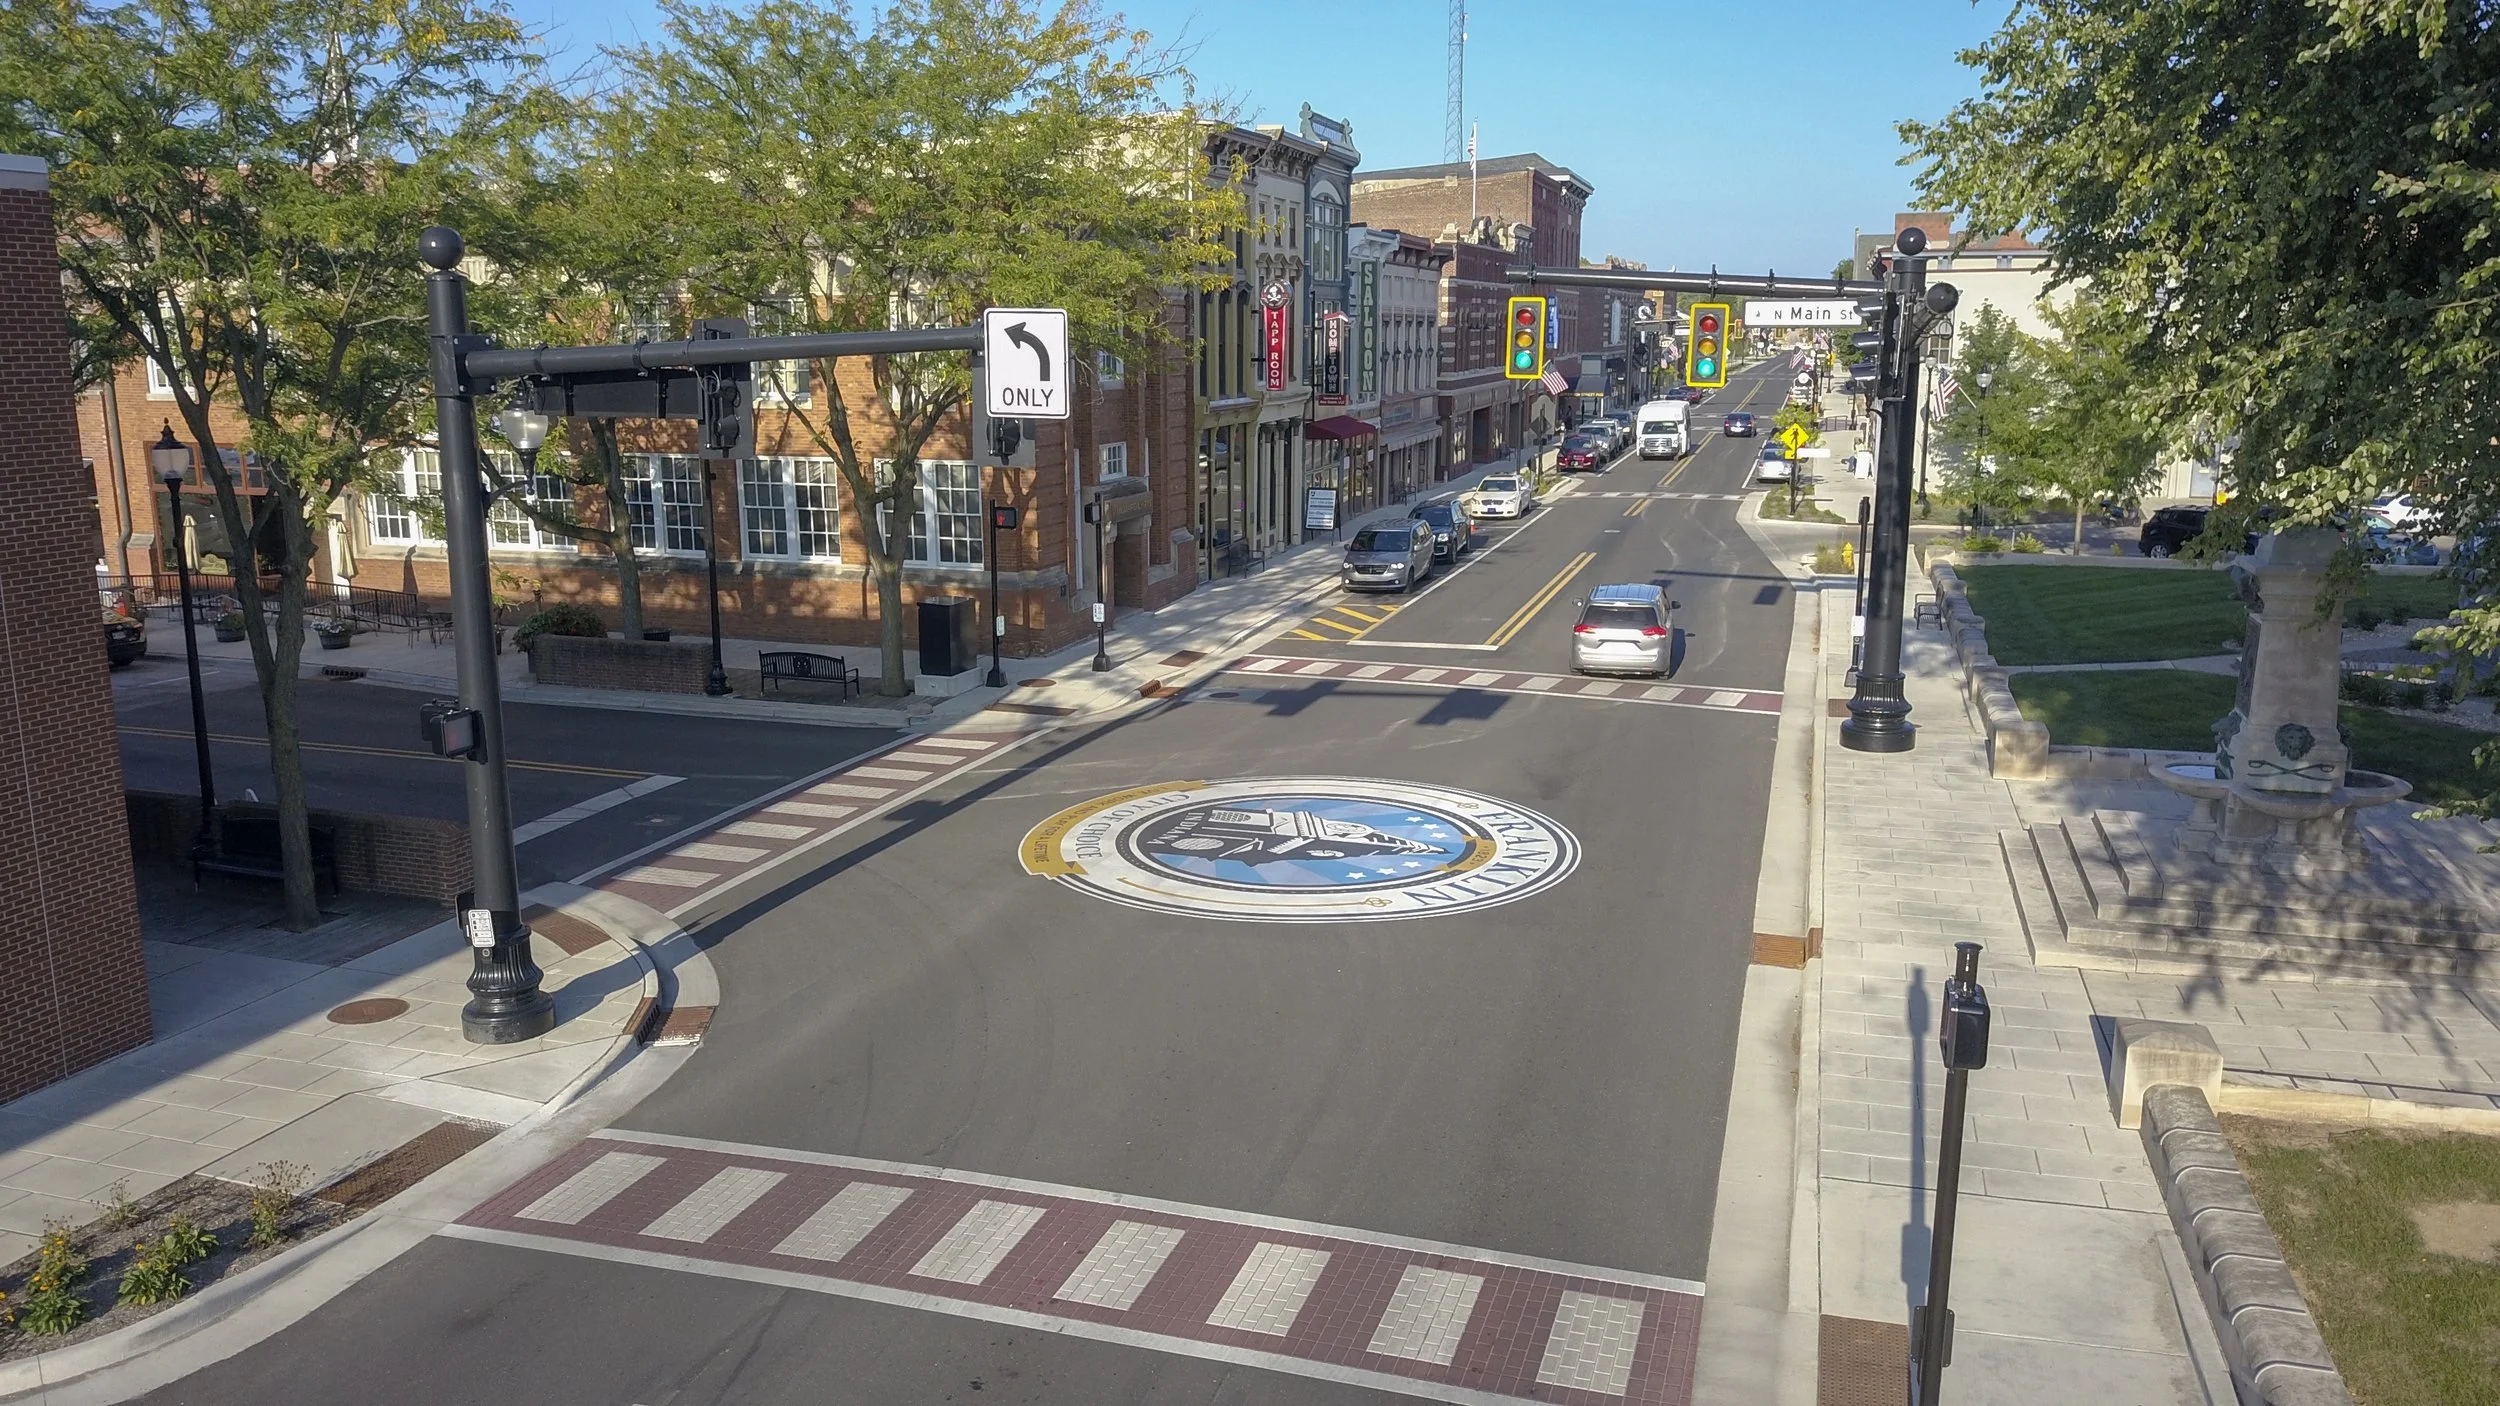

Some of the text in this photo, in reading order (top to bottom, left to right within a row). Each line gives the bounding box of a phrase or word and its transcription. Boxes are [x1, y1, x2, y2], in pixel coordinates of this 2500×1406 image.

[1363, 263, 1374, 391] SALOON
[1774, 306, 1853, 320] N Main St
[1270, 311, 1280, 386] TAPP ROOM
[1328, 320, 1338, 392] HOMETOWN
[1002, 387, 1054, 407] ONLY
[1075, 794, 1191, 859] CITY OF CHOICE
[1146, 812, 1205, 845] INDIANA
[1402, 811, 1551, 906] FRANKLIN
